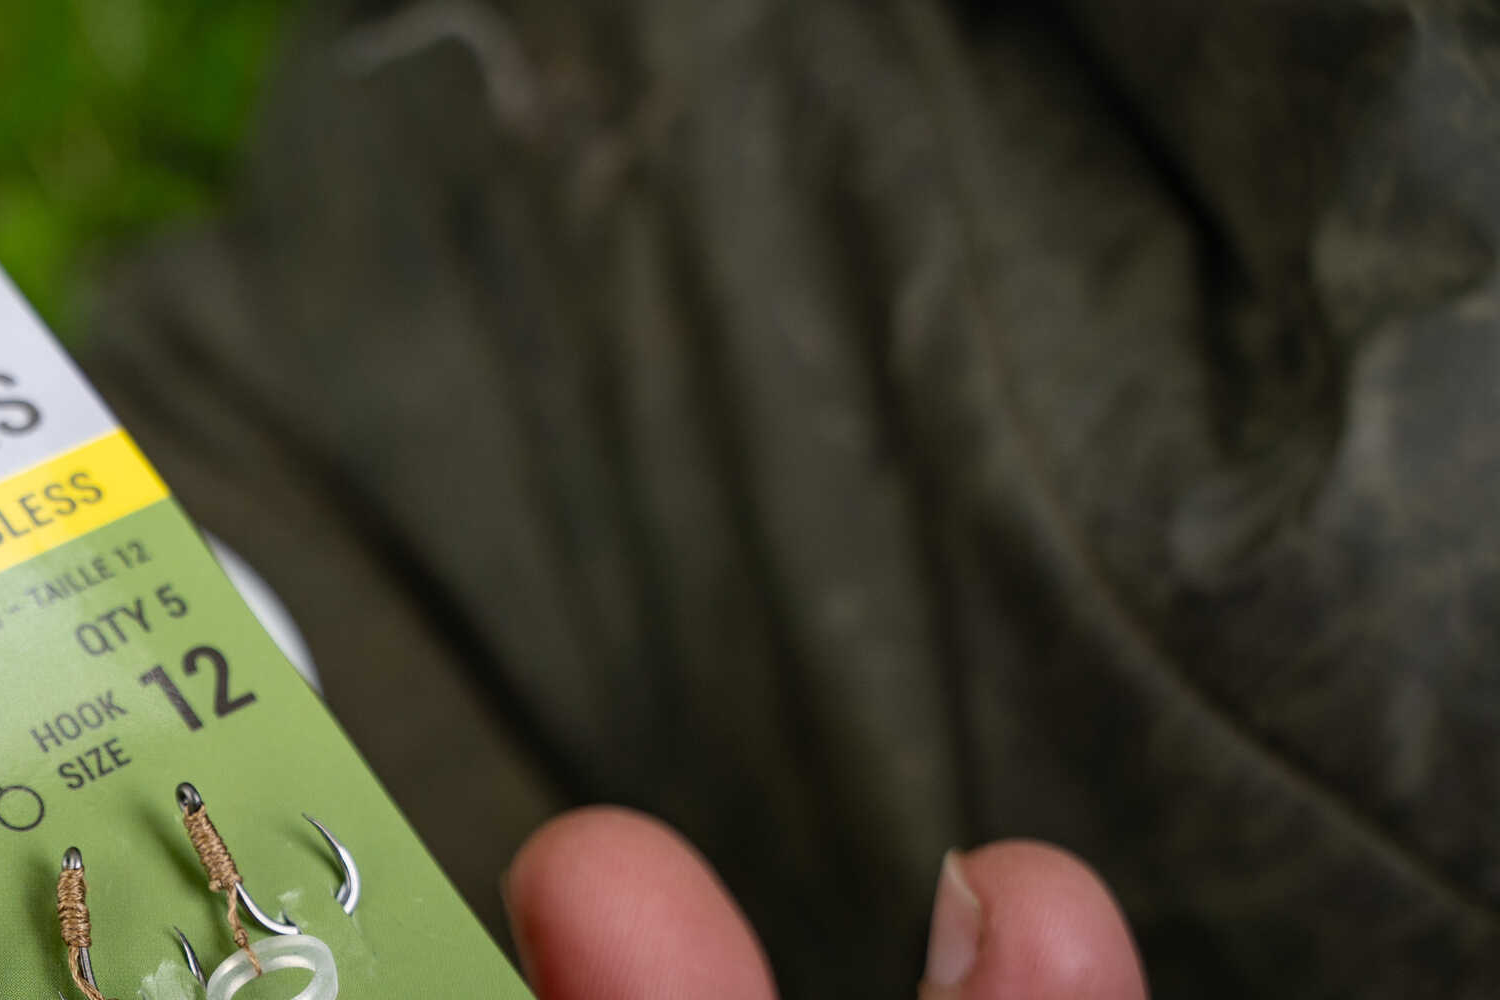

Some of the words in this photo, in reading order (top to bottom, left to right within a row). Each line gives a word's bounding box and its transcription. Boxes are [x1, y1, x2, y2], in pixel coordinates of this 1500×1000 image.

[25, 556, 117, 609] TAILLE
[113, 539, 153, 569] 12
[75, 597, 151, 657] QTY
[156, 583, 188, 618] 5
[30, 690, 128, 753] HOOK
[139, 645, 257, 732] 12
[57, 738, 132, 790] SIZE
